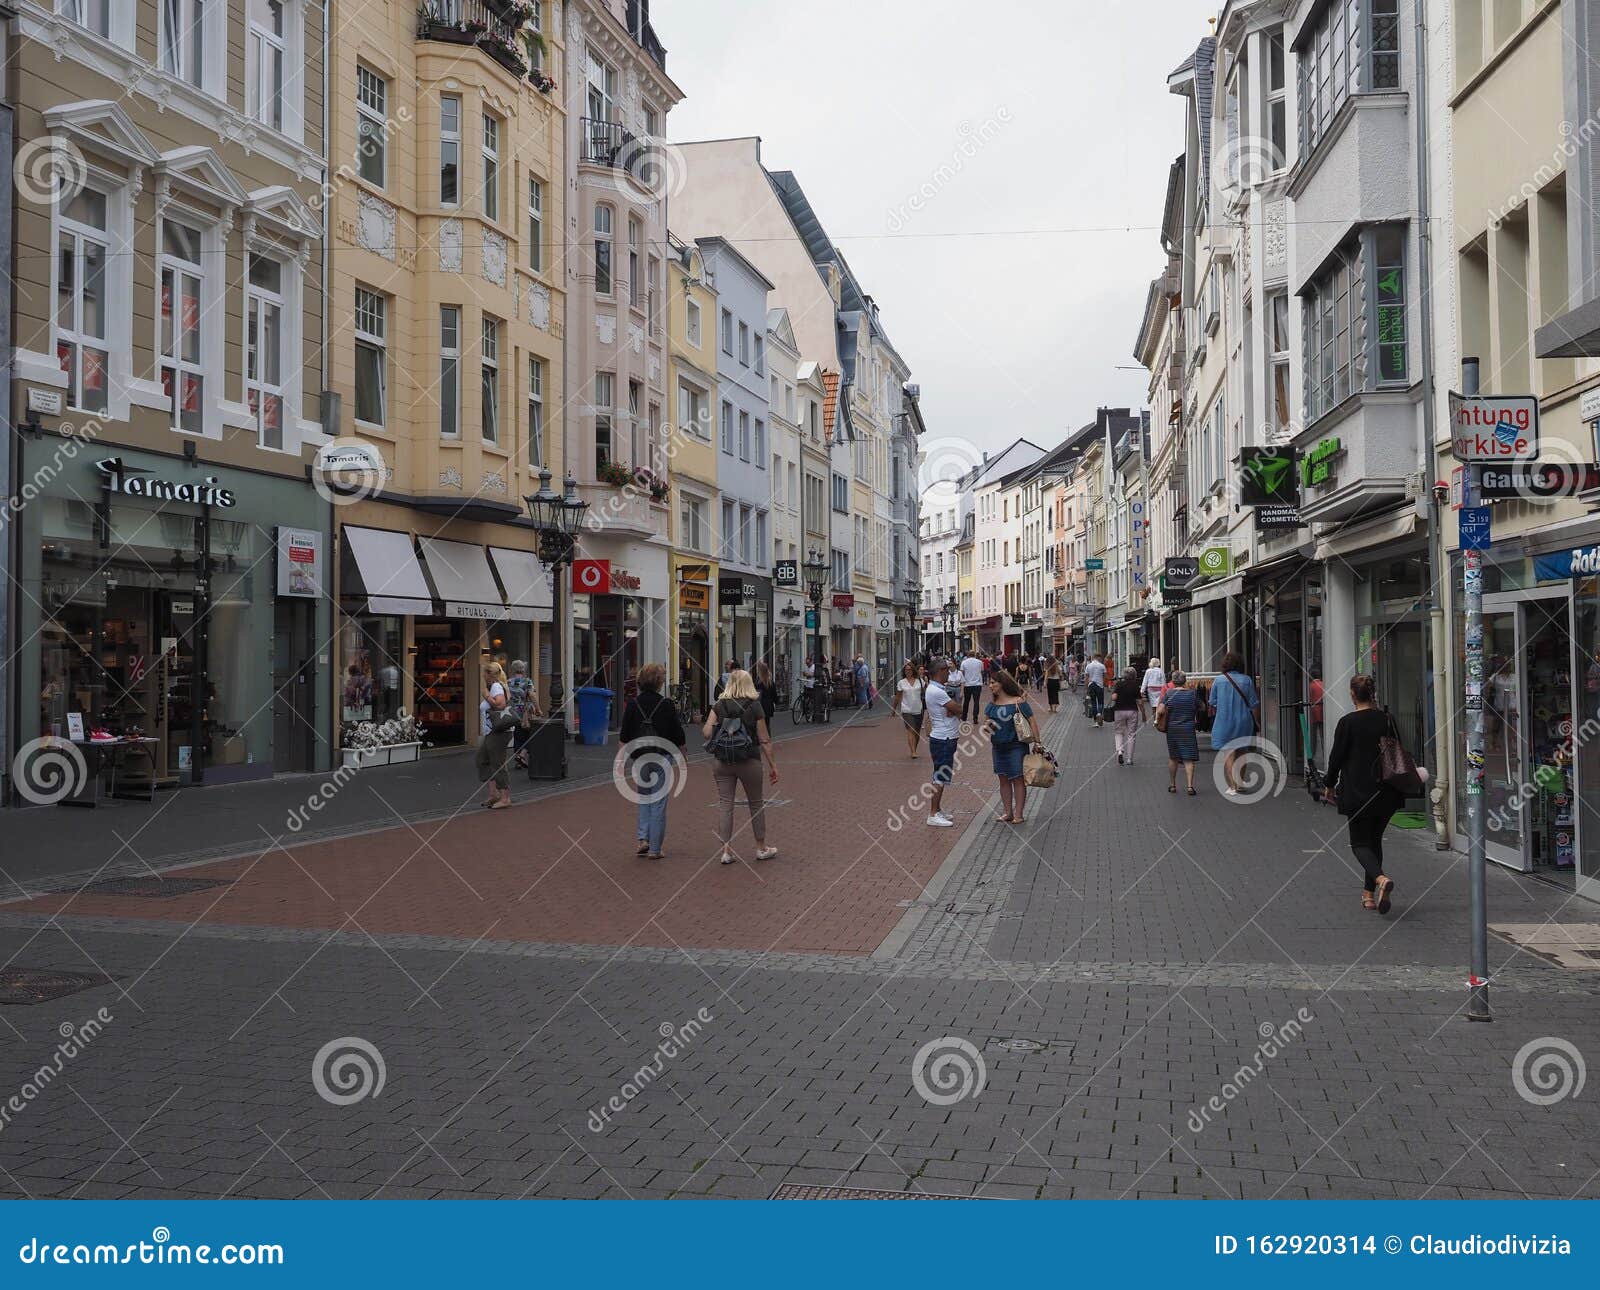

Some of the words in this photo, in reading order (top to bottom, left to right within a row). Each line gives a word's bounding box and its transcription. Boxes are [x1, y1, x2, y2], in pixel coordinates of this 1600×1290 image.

[323, 453, 369, 462] Tamaris
[95, 457, 236, 508] Tamaris
[1132, 503, 1143, 584] OPTIK
[1168, 567, 1196, 575] ONLY
